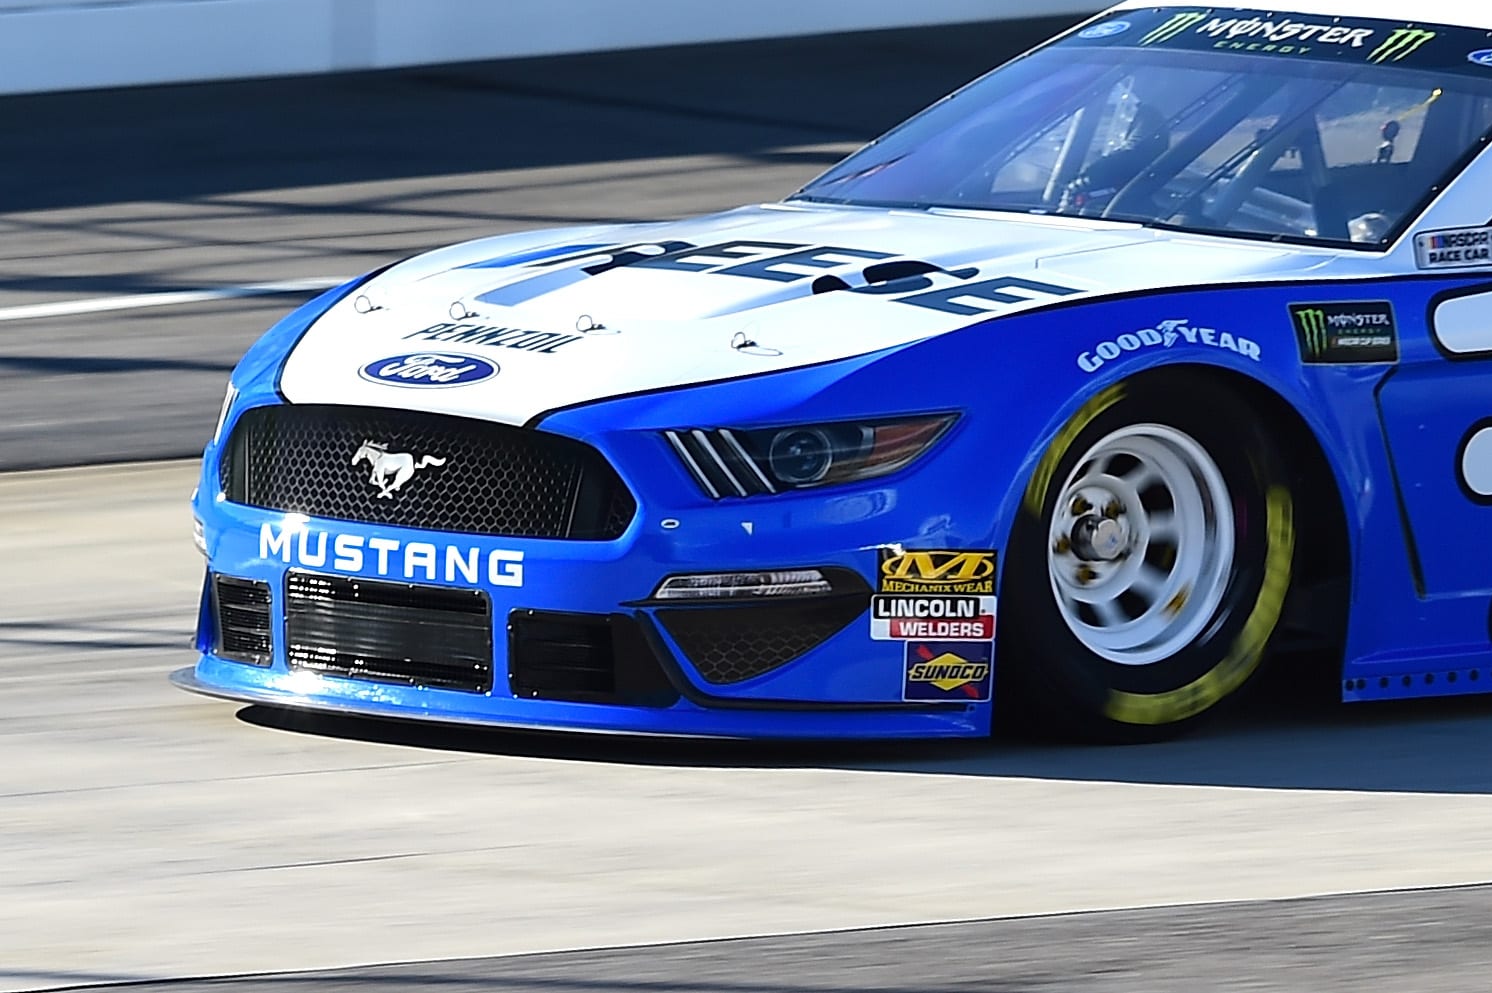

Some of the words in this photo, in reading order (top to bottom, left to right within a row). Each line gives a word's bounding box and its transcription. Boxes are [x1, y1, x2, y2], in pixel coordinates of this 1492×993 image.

[1213, 41, 1312, 55] ENERGY
[1429, 250, 1461, 264] RACE
[1464, 248, 1489, 260] CAR
[402, 322, 586, 354] PENNZOIL
[1077, 319, 1261, 373] GOODYEAR
[378, 353, 478, 383] Ford
[259, 523, 525, 587] MUSTANG
[882, 579, 951, 593] MECHANIX
[954, 579, 993, 593] WEAR
[878, 598, 975, 618] LINCOLN
[900, 622, 985, 637] WELDERS
[911, 664, 986, 680] SUNOCO
